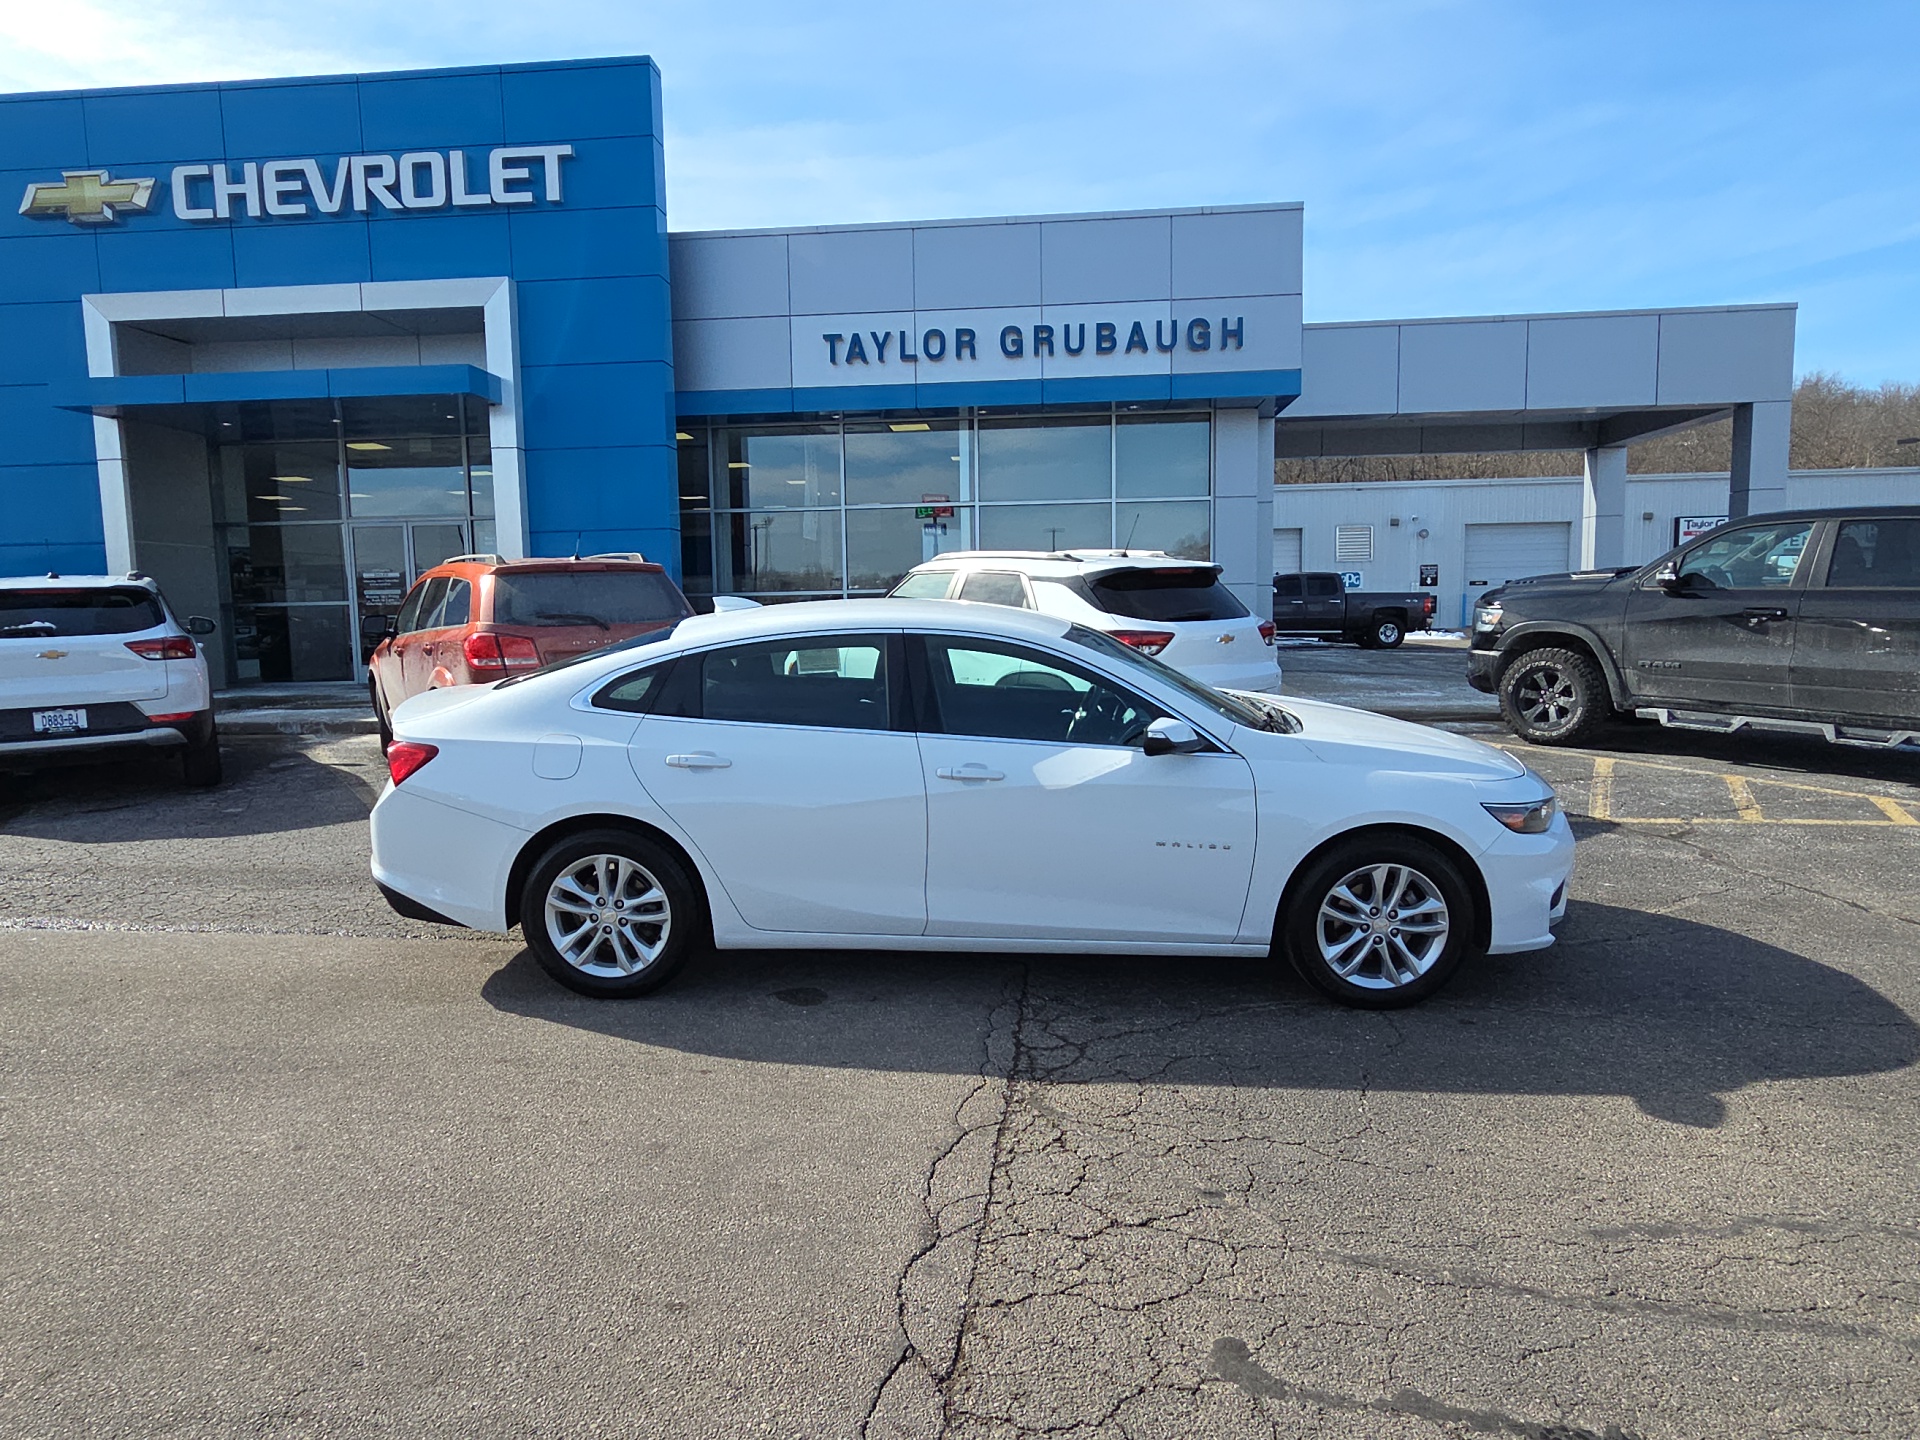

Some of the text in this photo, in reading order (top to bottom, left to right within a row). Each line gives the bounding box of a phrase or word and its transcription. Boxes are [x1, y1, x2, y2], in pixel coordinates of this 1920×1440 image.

[171, 144, 574, 221] CHEVROLET
[822, 316, 1245, 365] TAYLOR GRUBAUGH
[1684, 519, 1714, 530] Taylor
[1156, 841, 1231, 850] MALIBU
